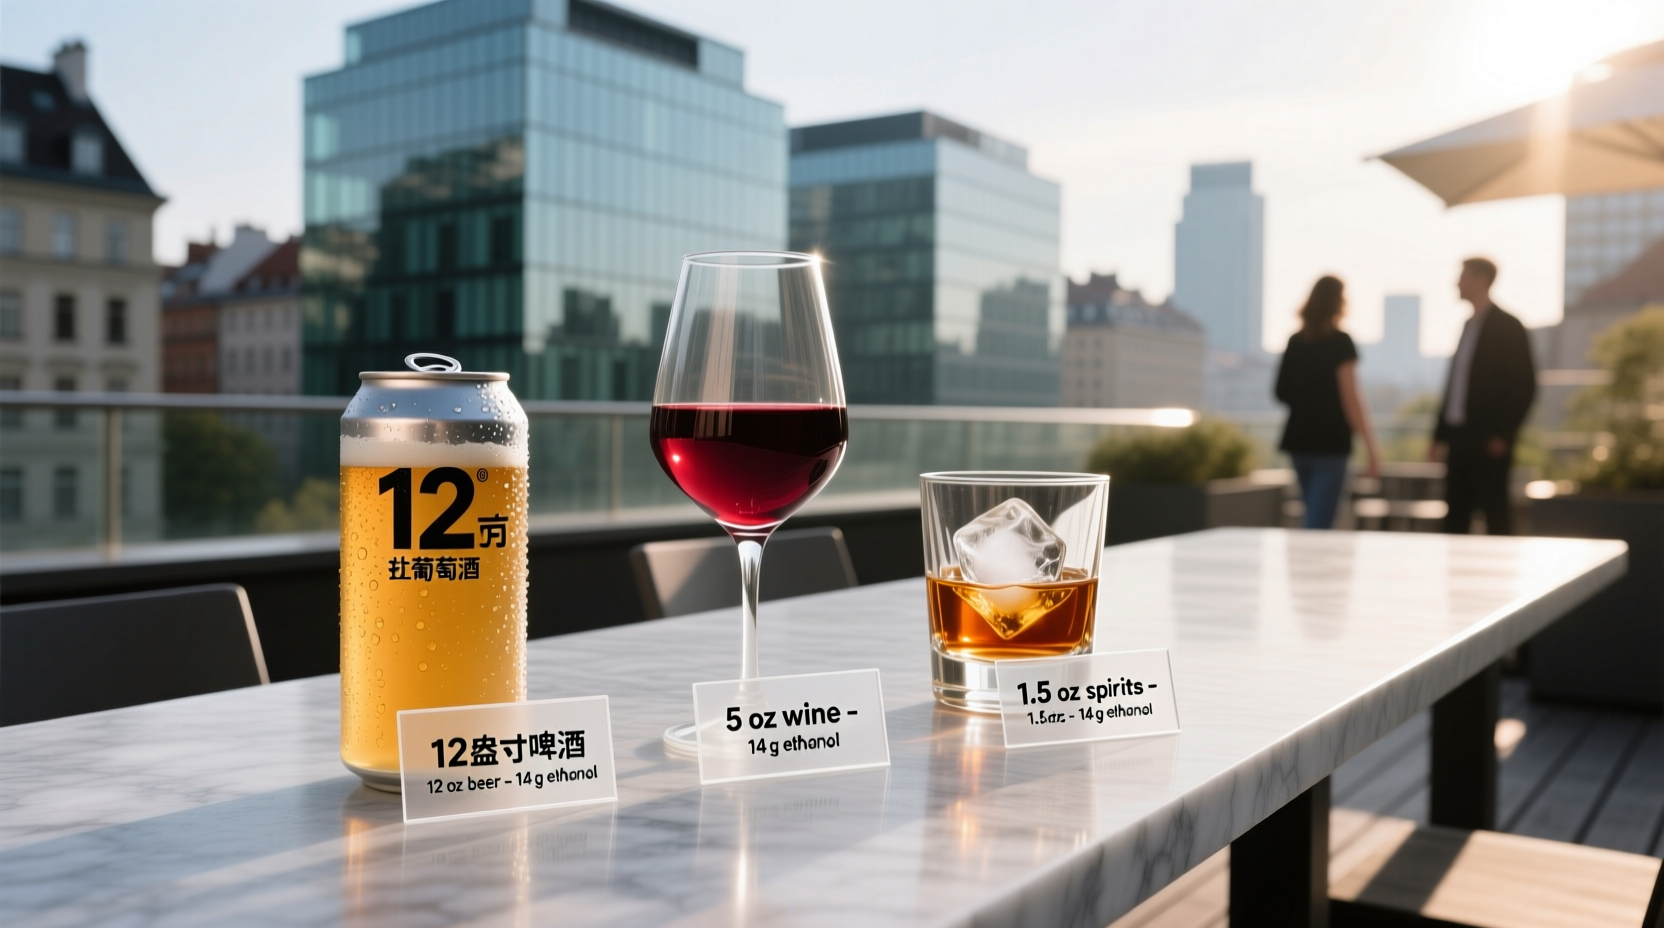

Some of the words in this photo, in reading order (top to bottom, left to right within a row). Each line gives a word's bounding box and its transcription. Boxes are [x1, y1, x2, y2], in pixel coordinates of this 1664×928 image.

[378, 466, 475, 550] 12
[1016, 680, 1052, 706] 1.5
[1057, 685, 1081, 702] oz
[1085, 676, 1144, 704] spirits
[726, 706, 743, 732] 5
[748, 711, 778, 730] oz
[781, 701, 841, 727] wine
[1078, 706, 1094, 721] 14
[1095, 709, 1104, 724] g
[748, 738, 768, 755] 14
[769, 740, 779, 757] g
[782, 731, 840, 752] ethanol
[426, 778, 444, 795] 12
[446, 780, 464, 793] oz
[467, 775, 502, 792] beer
[515, 771, 533, 787] 14
[534, 773, 544, 789] g
